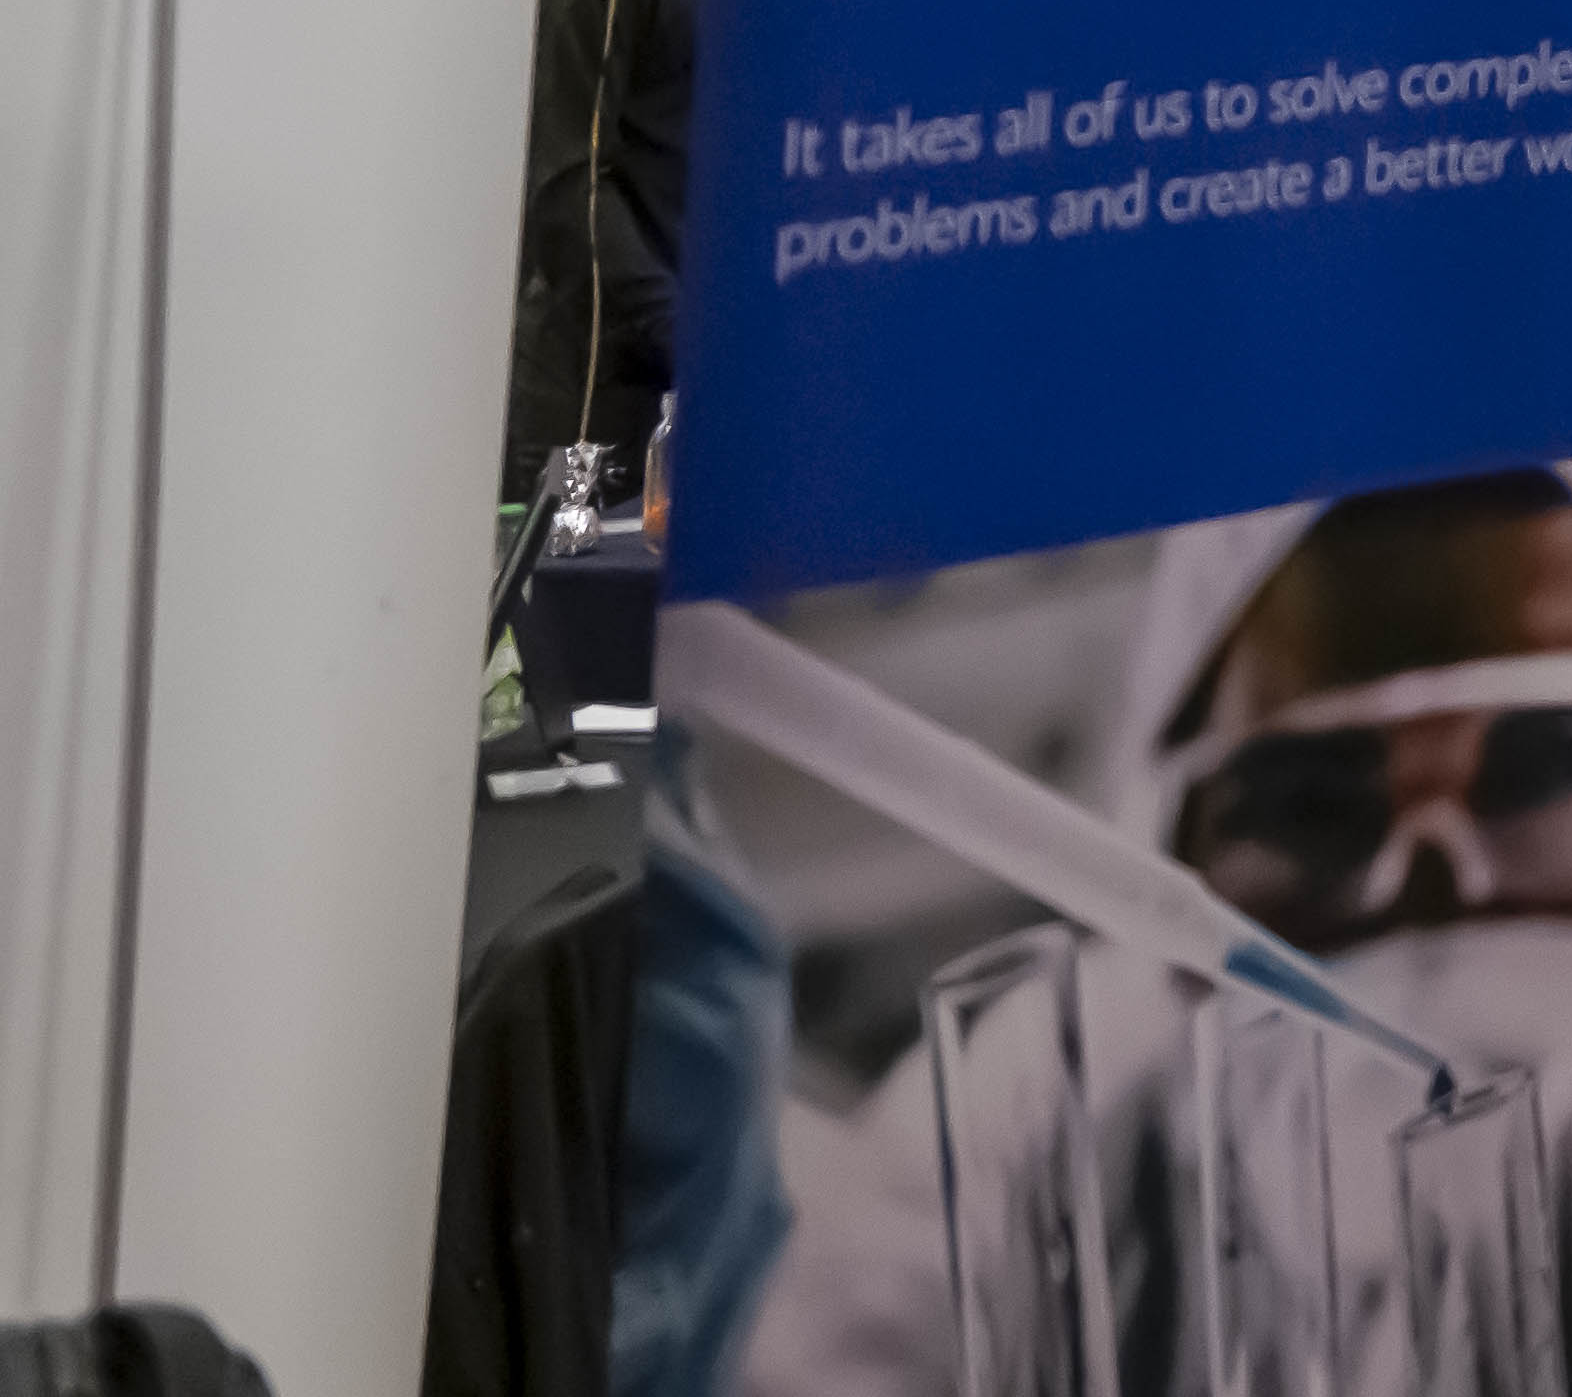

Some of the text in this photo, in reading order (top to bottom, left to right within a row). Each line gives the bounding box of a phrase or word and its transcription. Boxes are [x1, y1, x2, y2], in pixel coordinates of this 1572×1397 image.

[782, 120, 822, 178] It
[840, 109, 982, 174] takes
[995, 93, 1051, 154] all
[1065, 80, 1122, 146] of
[1134, 92, 1192, 140] us
[1204, 84, 1257, 130] to
[1268, 62, 1389, 123] solve
[776, 196, 1036, 280] problems
[1049, 173, 1147, 235] and
[1159, 159, 1311, 220] create
[1323, 155, 1351, 199] a
[1364, 139, 1511, 193] better
